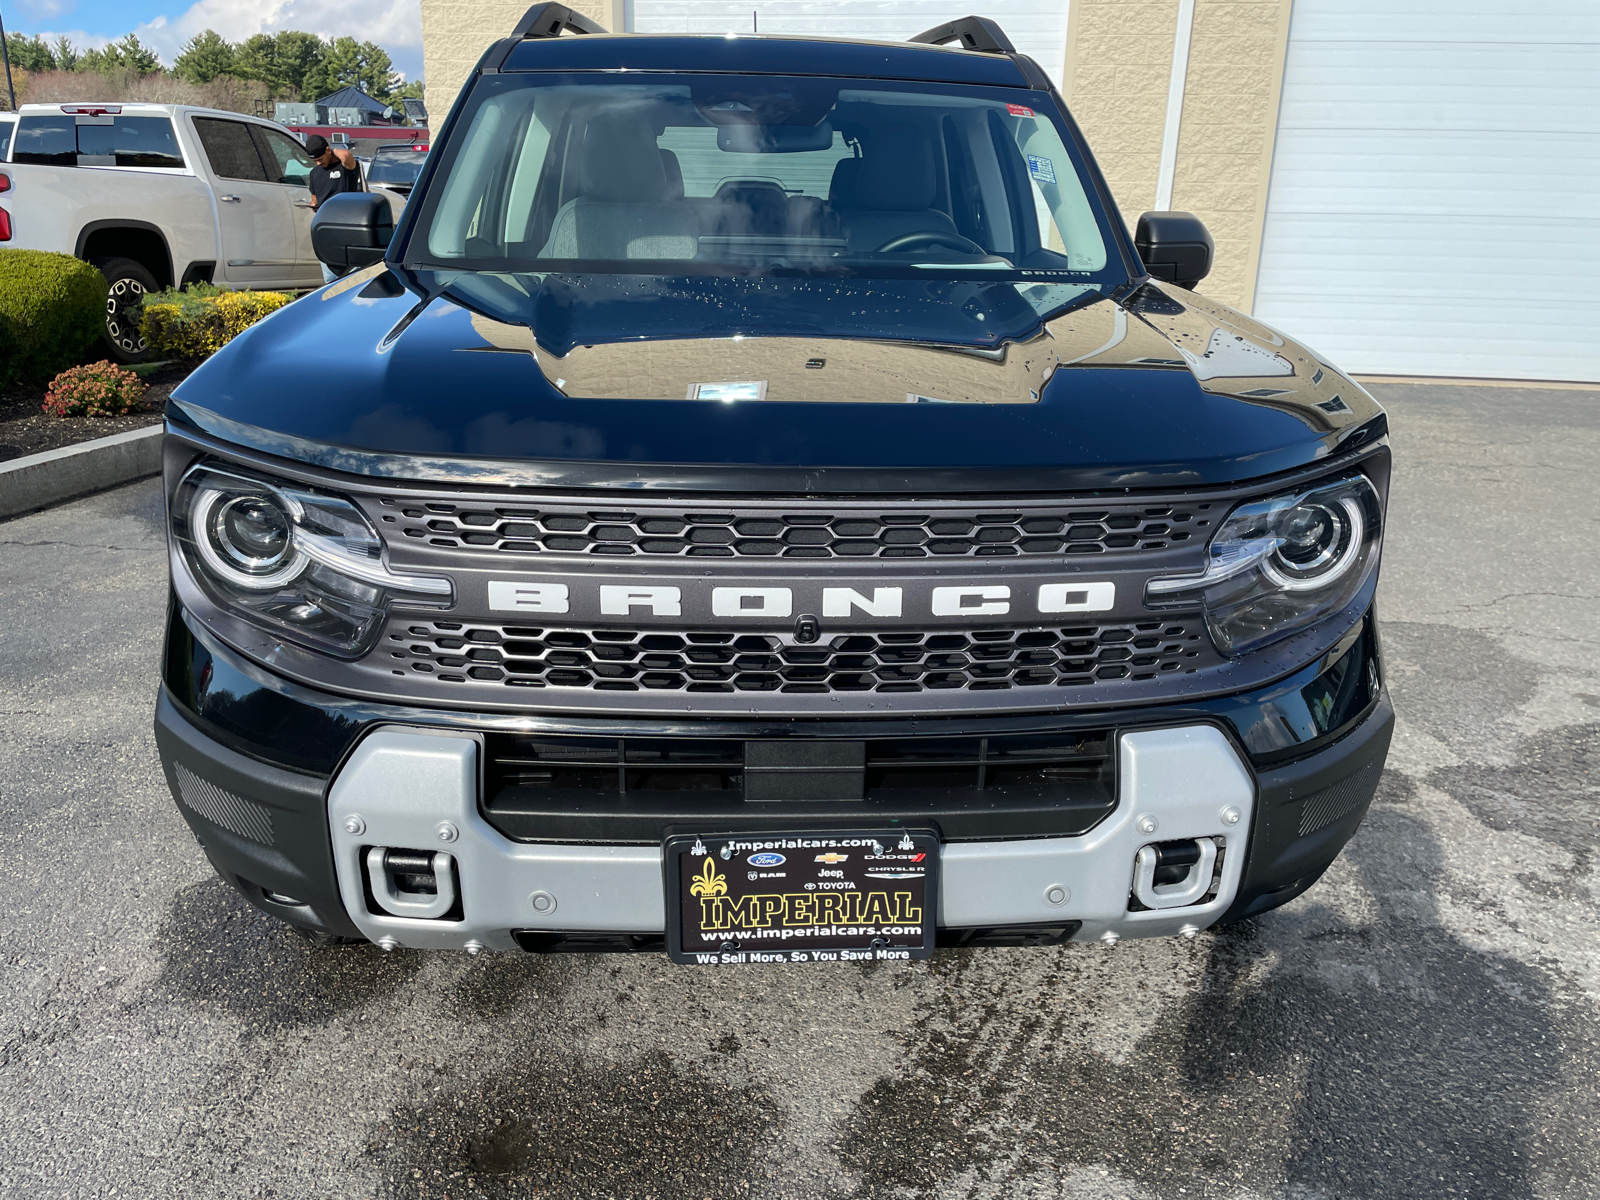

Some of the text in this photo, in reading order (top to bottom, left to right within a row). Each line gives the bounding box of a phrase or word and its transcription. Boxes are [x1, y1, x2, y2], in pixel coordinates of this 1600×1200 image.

[487, 580, 1116, 618] BRONCO
[728, 837, 877, 852] Imperialcars.com
[755, 855, 777, 865] Ford
[818, 869, 844, 879] Jeep
[818, 881, 856, 890] TOYOTA
[700, 892, 922, 931] IMPERIAL
[700, 925, 922, 941] www.imperialcars.com
[696, 949, 910, 964] We Sell More, So You Save More
